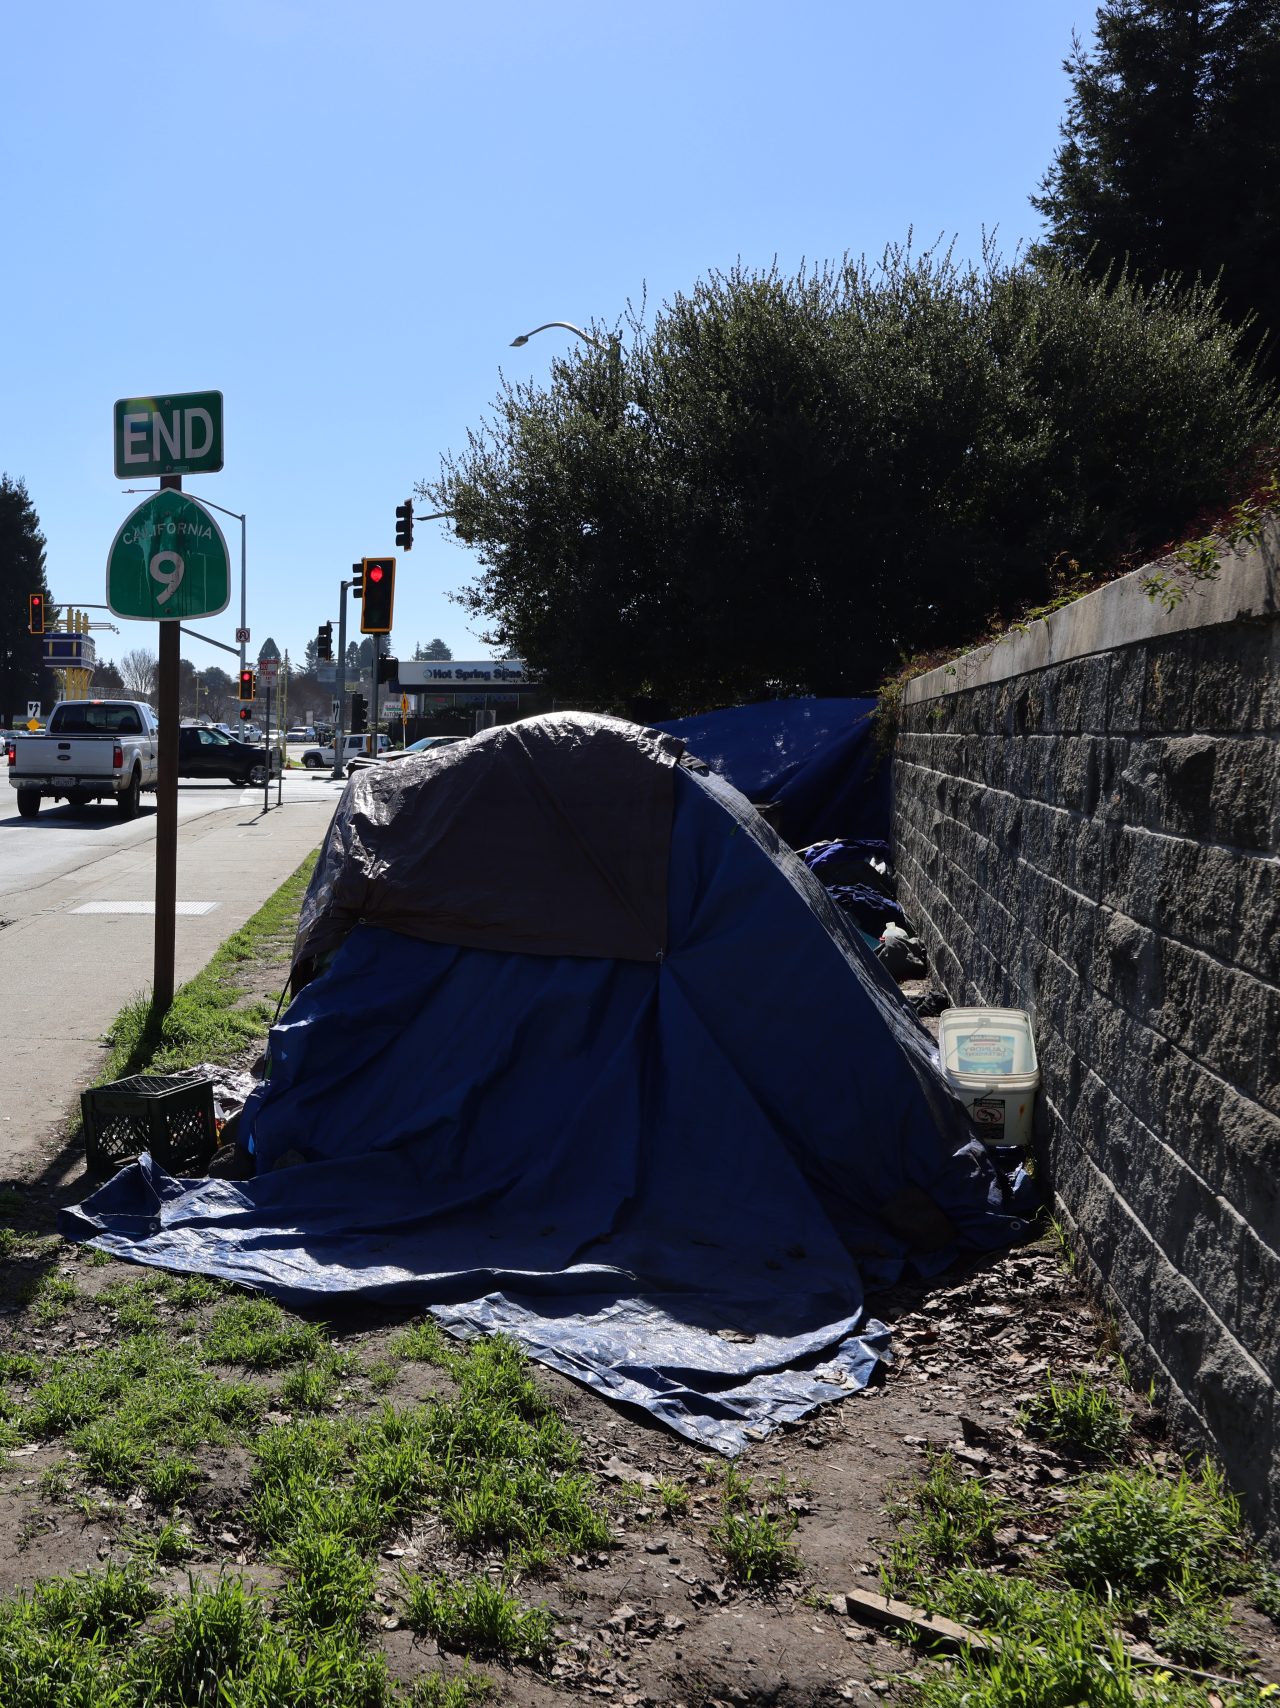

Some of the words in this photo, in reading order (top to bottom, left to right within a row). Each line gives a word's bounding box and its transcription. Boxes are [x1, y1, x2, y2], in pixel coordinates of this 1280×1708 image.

[123, 407, 214, 464] END
[123, 522, 212, 545] CALIFORNIA
[149, 550, 185, 605] 9
[433, 669, 452, 679] Hot
[455, 669, 491, 680] Spring
